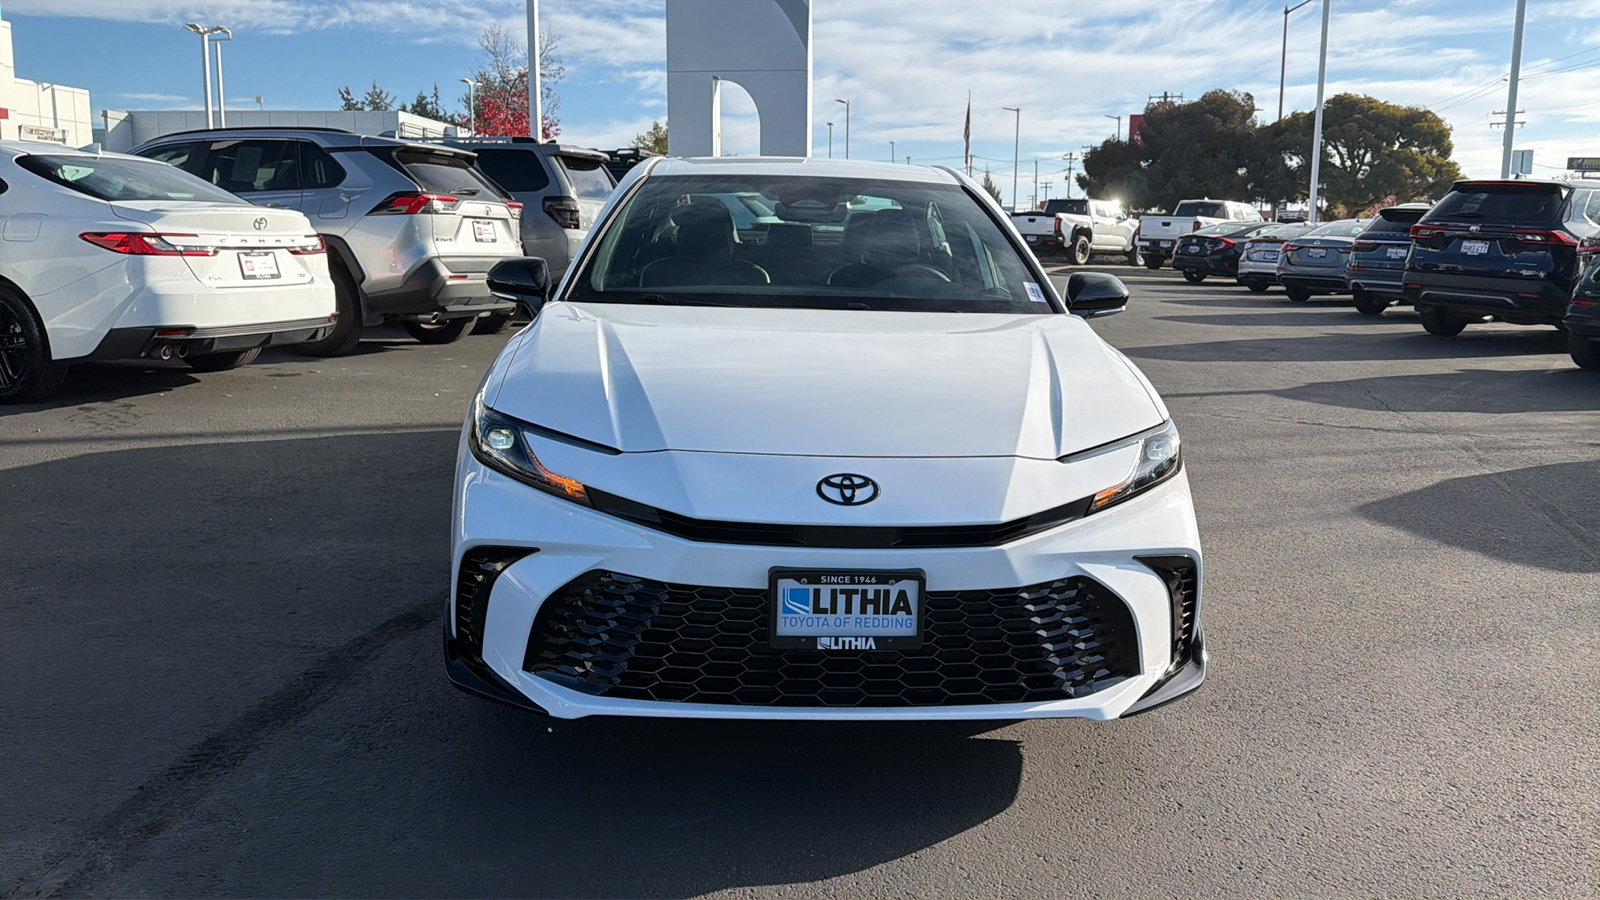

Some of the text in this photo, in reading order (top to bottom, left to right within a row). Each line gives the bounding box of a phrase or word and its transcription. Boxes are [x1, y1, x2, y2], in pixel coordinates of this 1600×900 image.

[820, 576, 877, 584] SINCE 1946
[812, 588, 913, 615] LITHIA
[782, 616, 913, 629] TOYOTA OF REDDING
[829, 637, 877, 650] LITHIA
